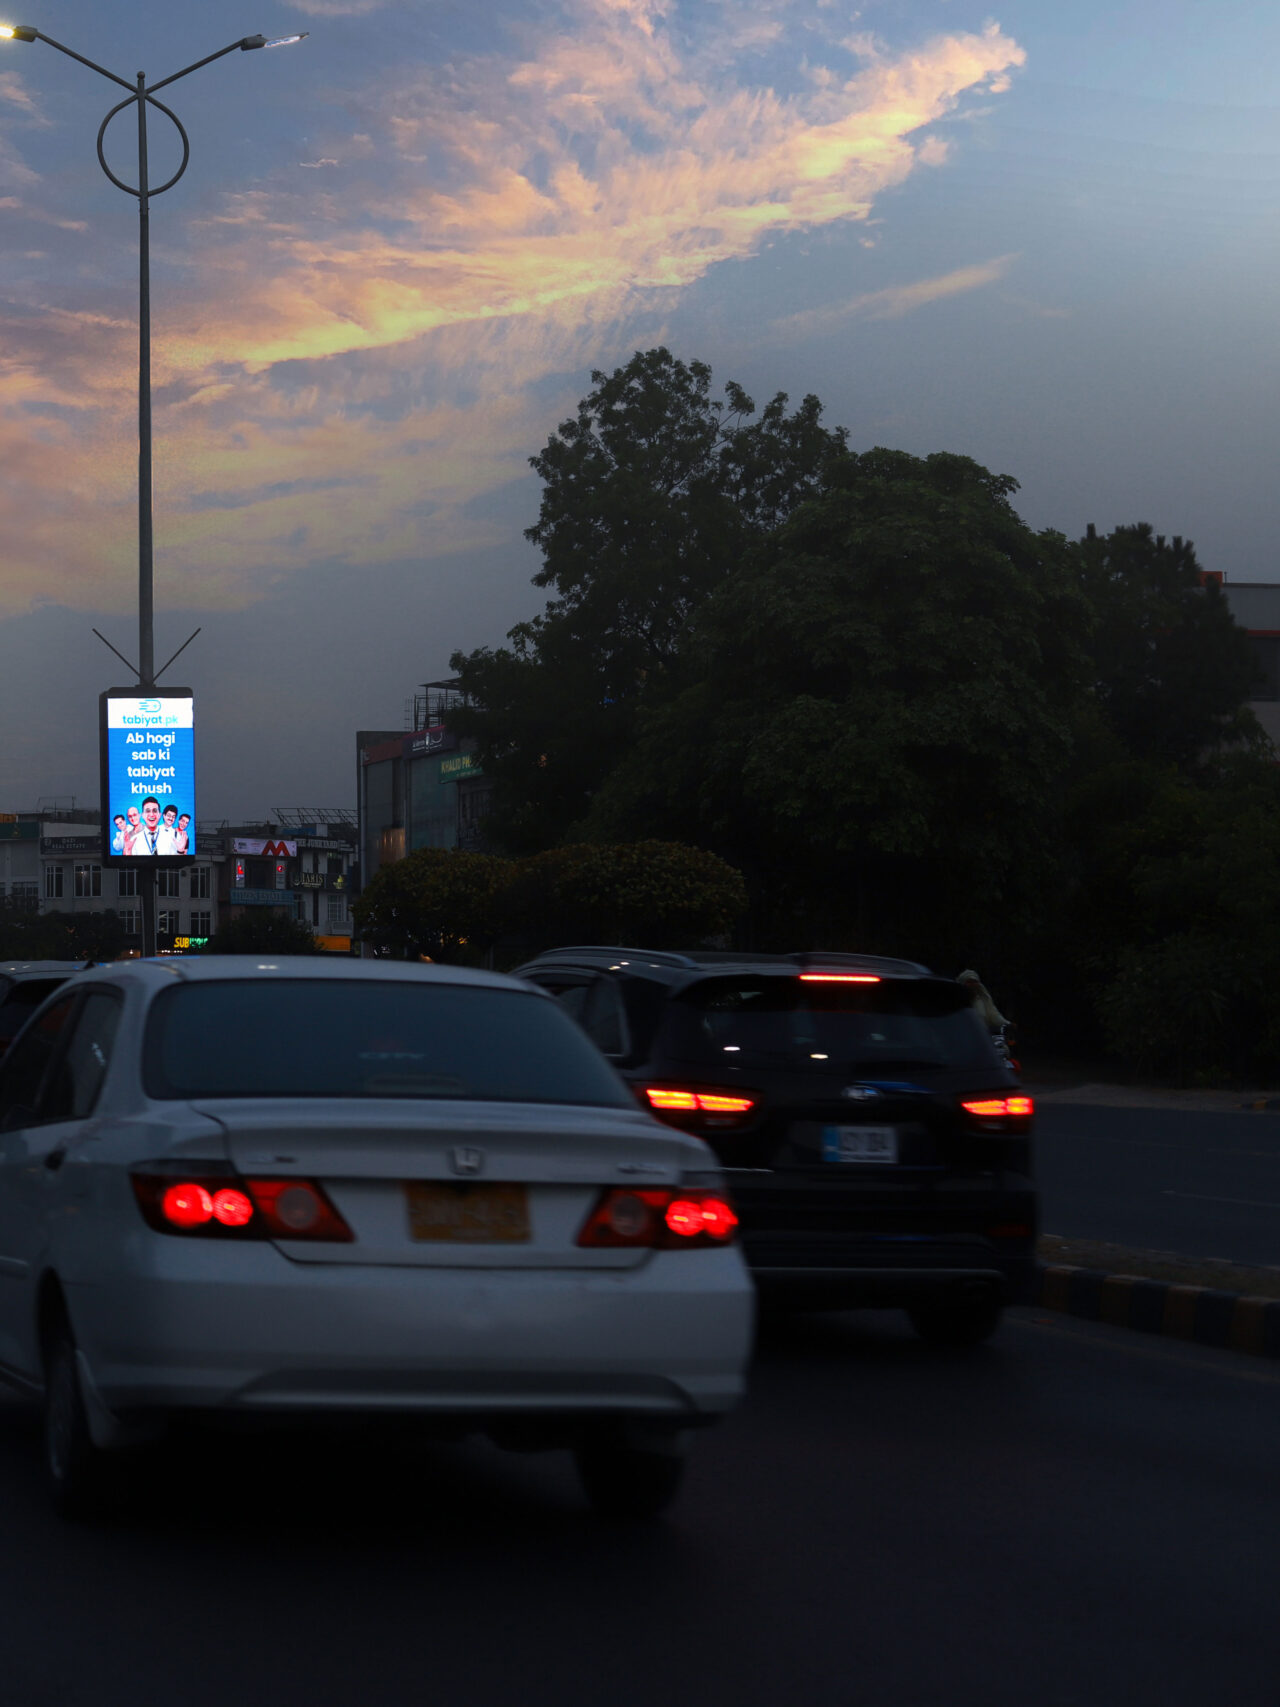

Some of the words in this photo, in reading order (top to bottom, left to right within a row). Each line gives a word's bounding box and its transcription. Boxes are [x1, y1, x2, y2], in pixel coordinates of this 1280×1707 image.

[125, 732, 145, 744] Ab
[146, 731, 176, 748] hogi
[131, 748, 157, 761] sab
[158, 748, 171, 761] ki
[126, 765, 176, 781] tabiyat
[131, 782, 173, 794] khush
